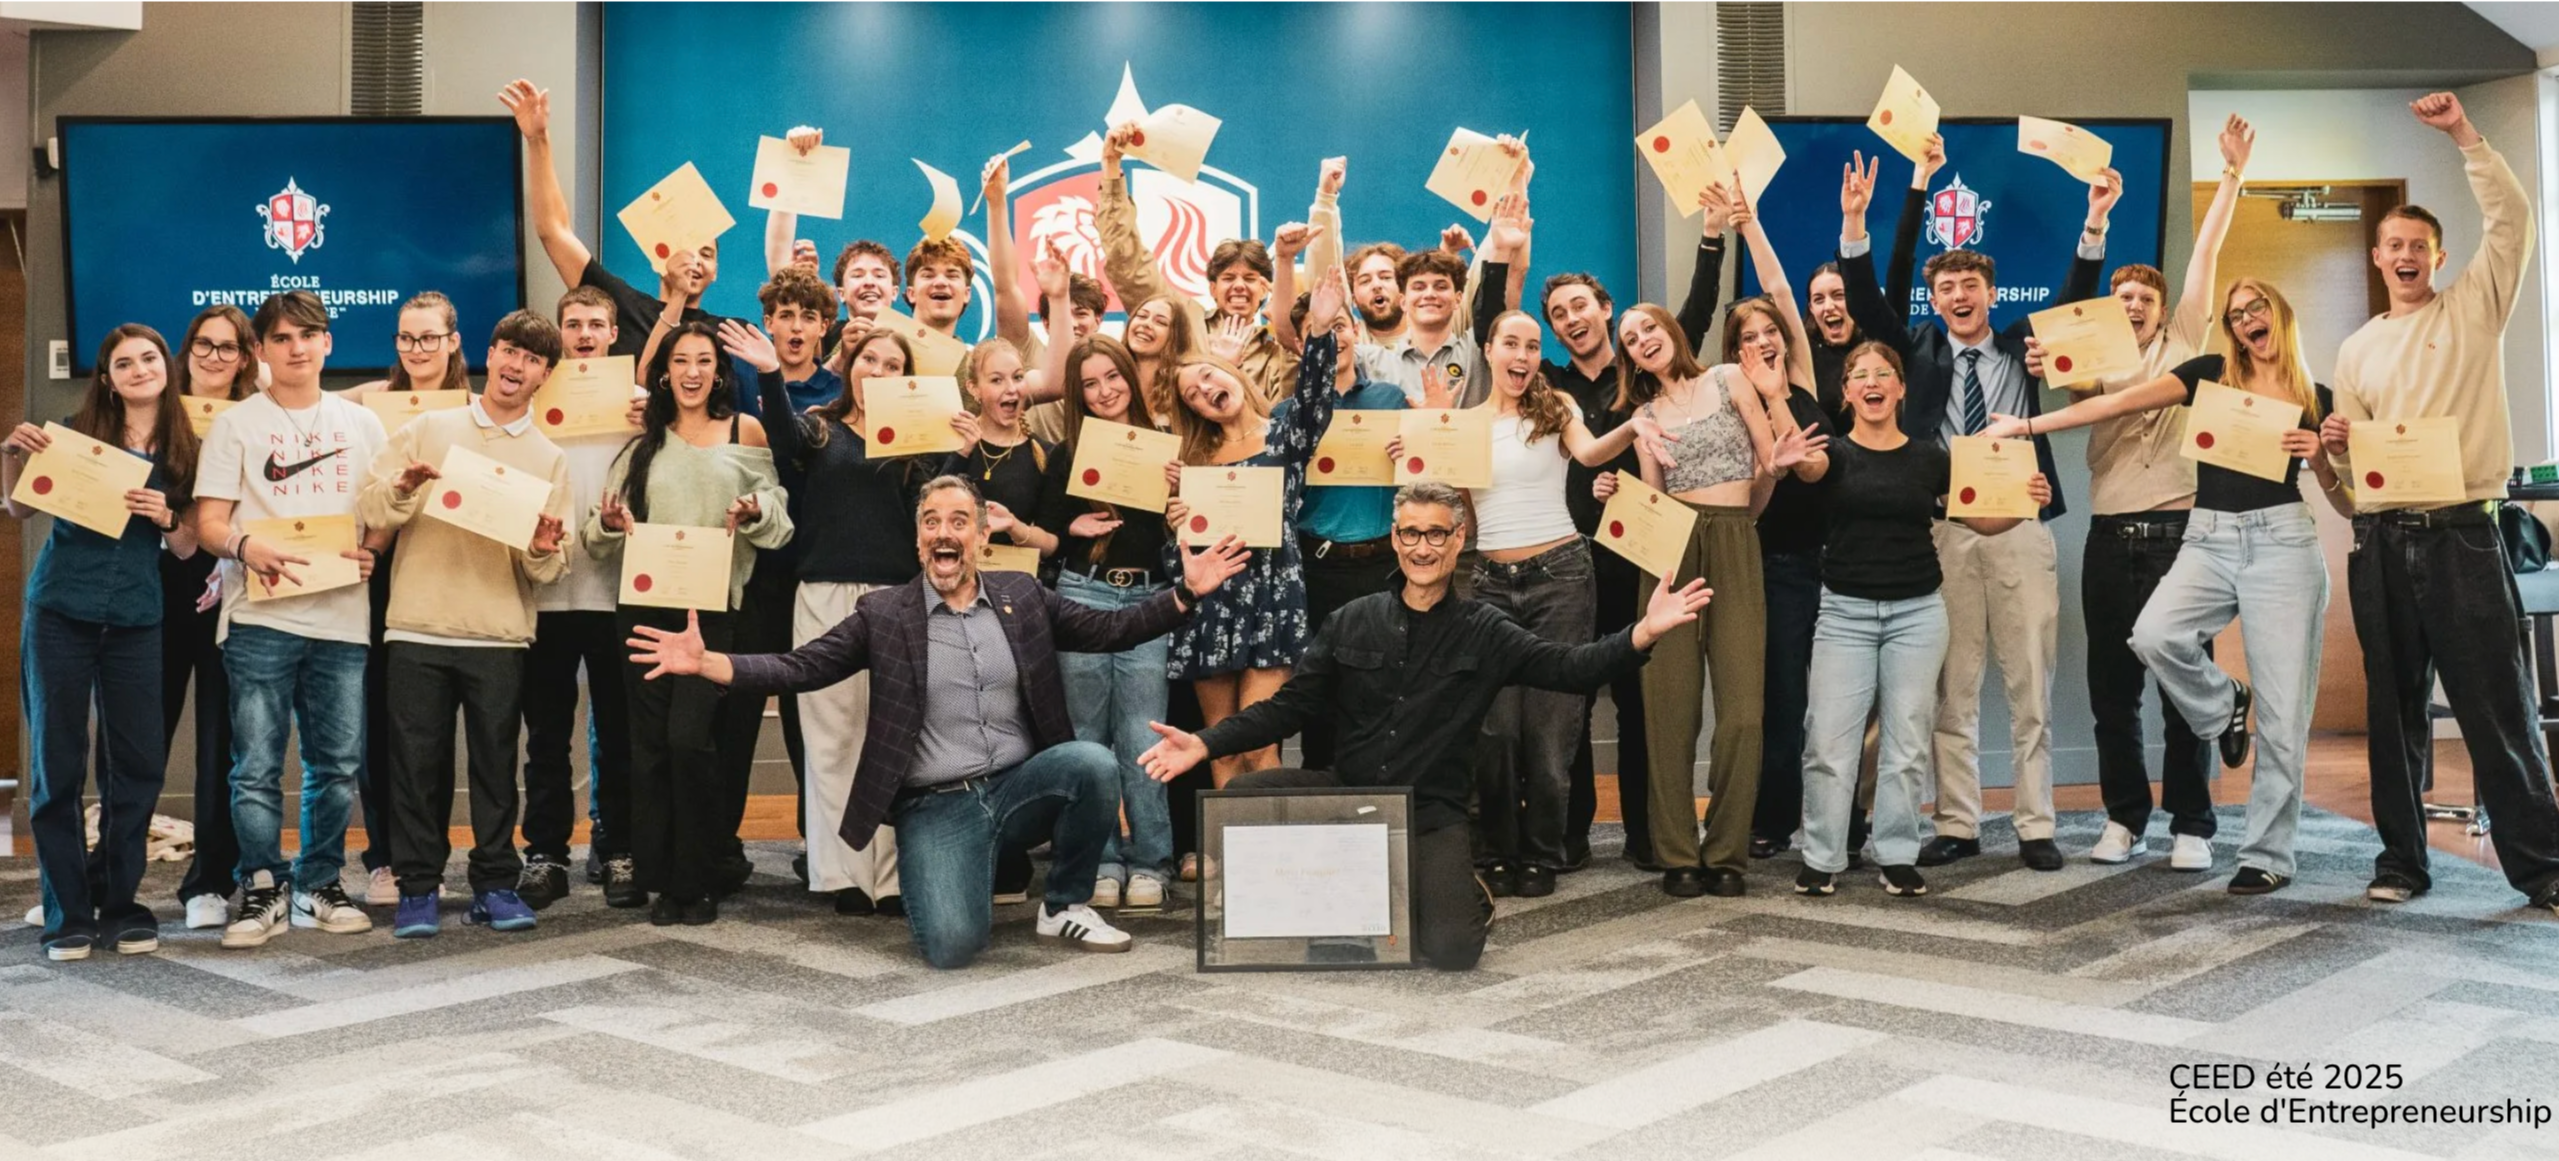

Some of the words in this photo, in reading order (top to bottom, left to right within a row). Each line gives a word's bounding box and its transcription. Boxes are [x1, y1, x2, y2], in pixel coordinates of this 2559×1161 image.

[270, 273, 321, 289] ÉCOLE
[270, 431, 347, 445] NIKE
[272, 448, 348, 461] NIKE
[272, 464, 349, 480] NIKE
[272, 481, 349, 496] NIKE
